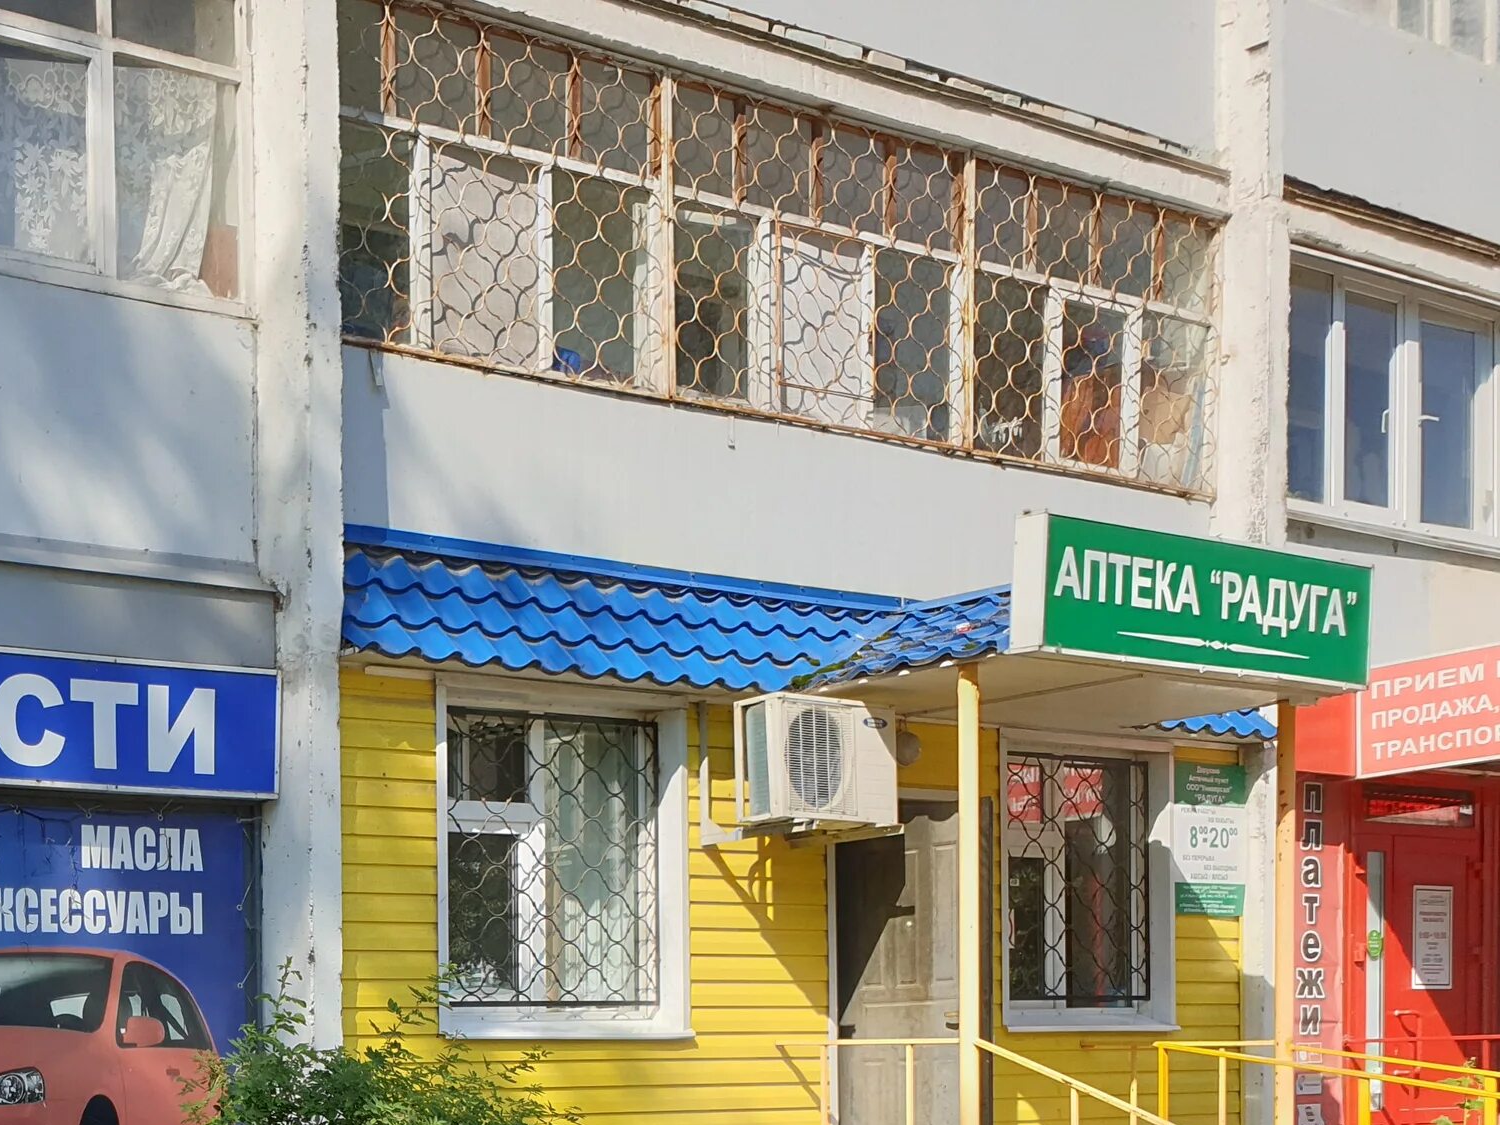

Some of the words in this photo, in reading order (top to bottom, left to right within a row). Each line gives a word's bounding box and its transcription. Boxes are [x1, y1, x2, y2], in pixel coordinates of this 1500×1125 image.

[1053, 546, 1200, 616] АПТЕКА
[1371, 663, 1484, 700] ПРИЕМ
[1371, 693, 1500, 730] ПРОДАЖА,
[81, 824, 204, 872] МАСЛА
[1295, 781, 1325, 1036] платежи
